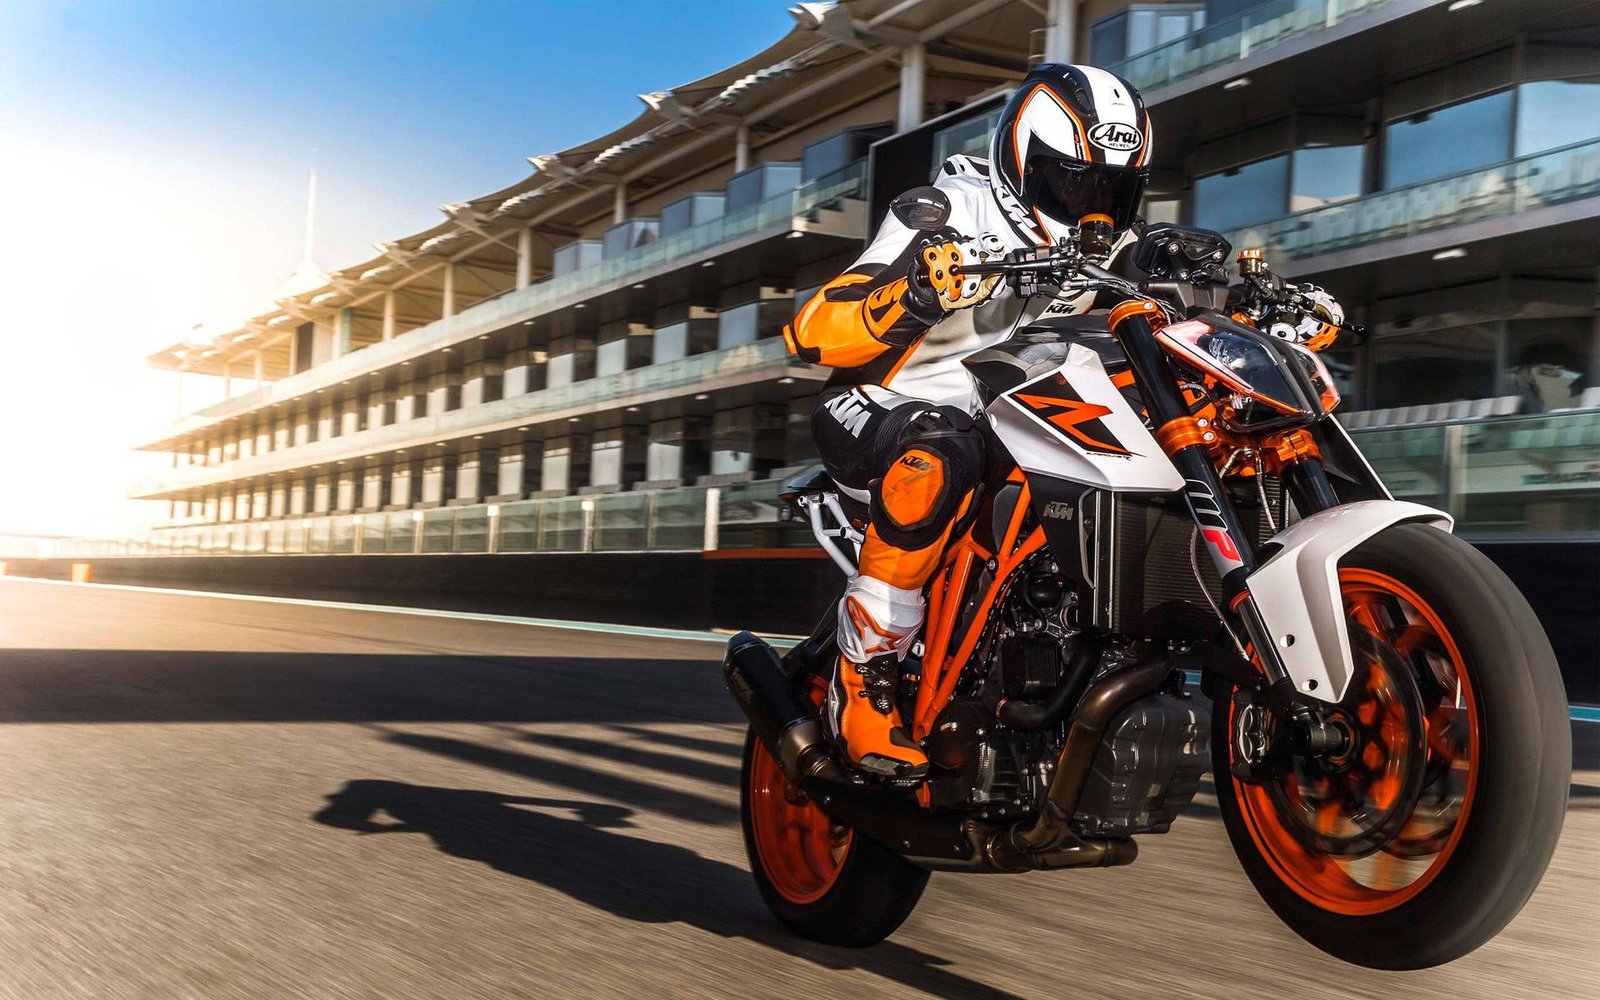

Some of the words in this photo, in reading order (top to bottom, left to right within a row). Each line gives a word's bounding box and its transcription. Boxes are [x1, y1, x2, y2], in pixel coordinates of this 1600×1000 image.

[1094, 124, 1138, 145] Arai
[1045, 303, 1077, 315] KTM
[824, 387, 871, 438] KTM
[1042, 501, 1074, 521] KTM
